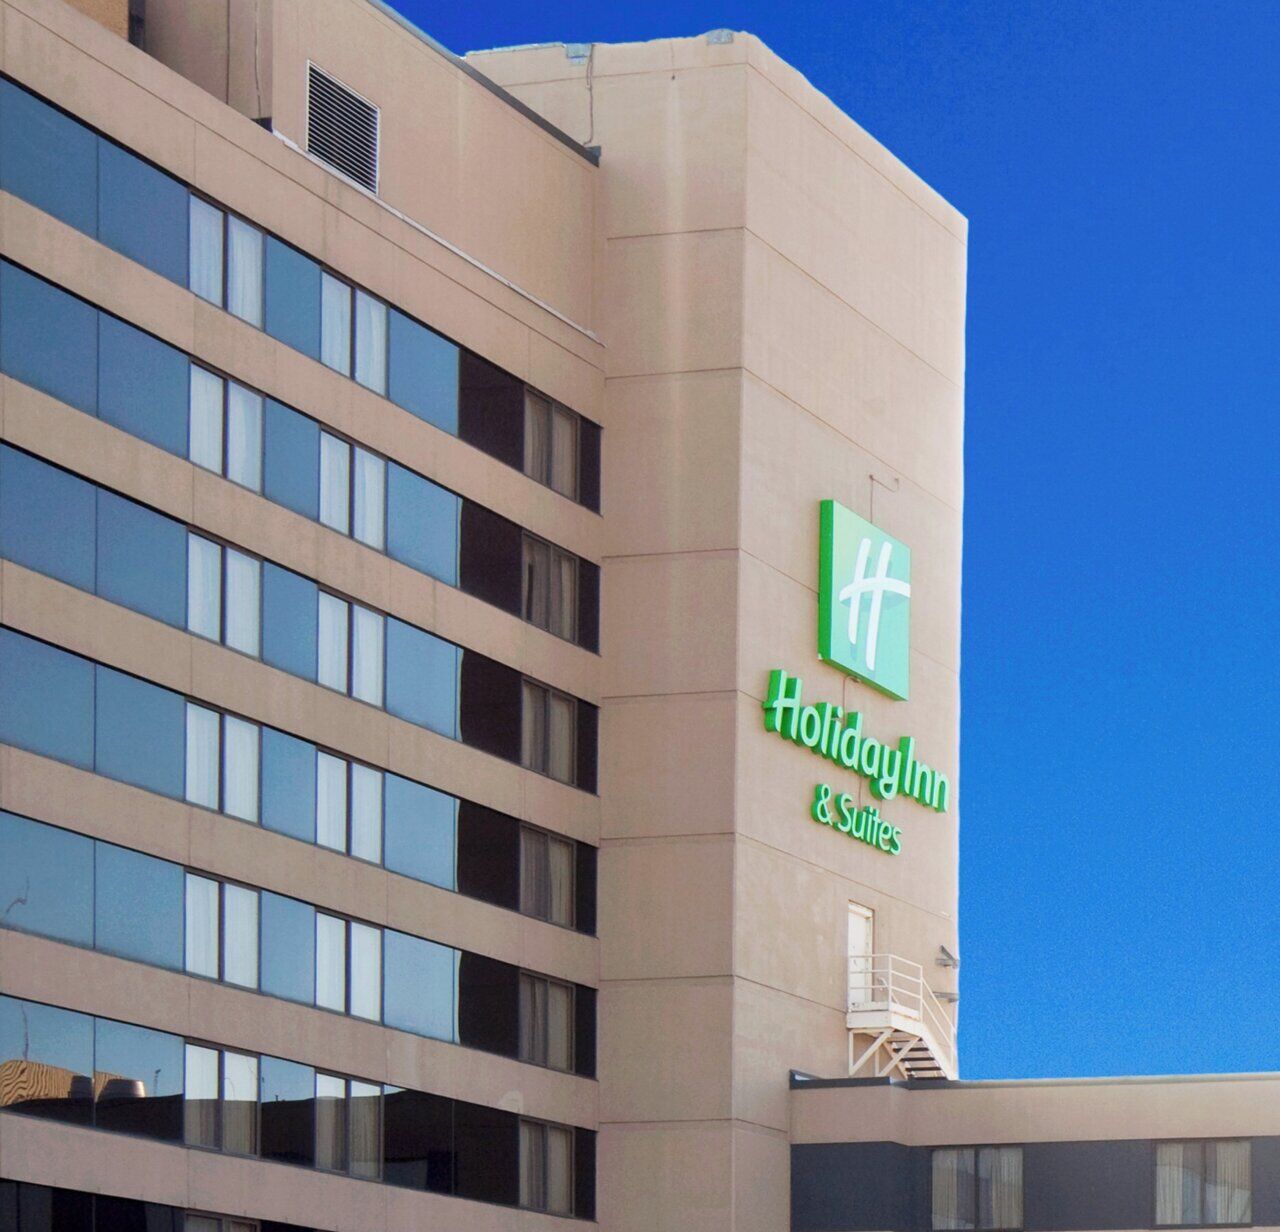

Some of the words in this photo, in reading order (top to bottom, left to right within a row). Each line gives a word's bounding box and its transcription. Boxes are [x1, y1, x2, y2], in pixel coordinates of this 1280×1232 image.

[763, 669, 901, 800] Holiday
[899, 736, 950, 813] Inn
[811, 783, 834, 829] &
[835, 792, 902, 857] Suites
